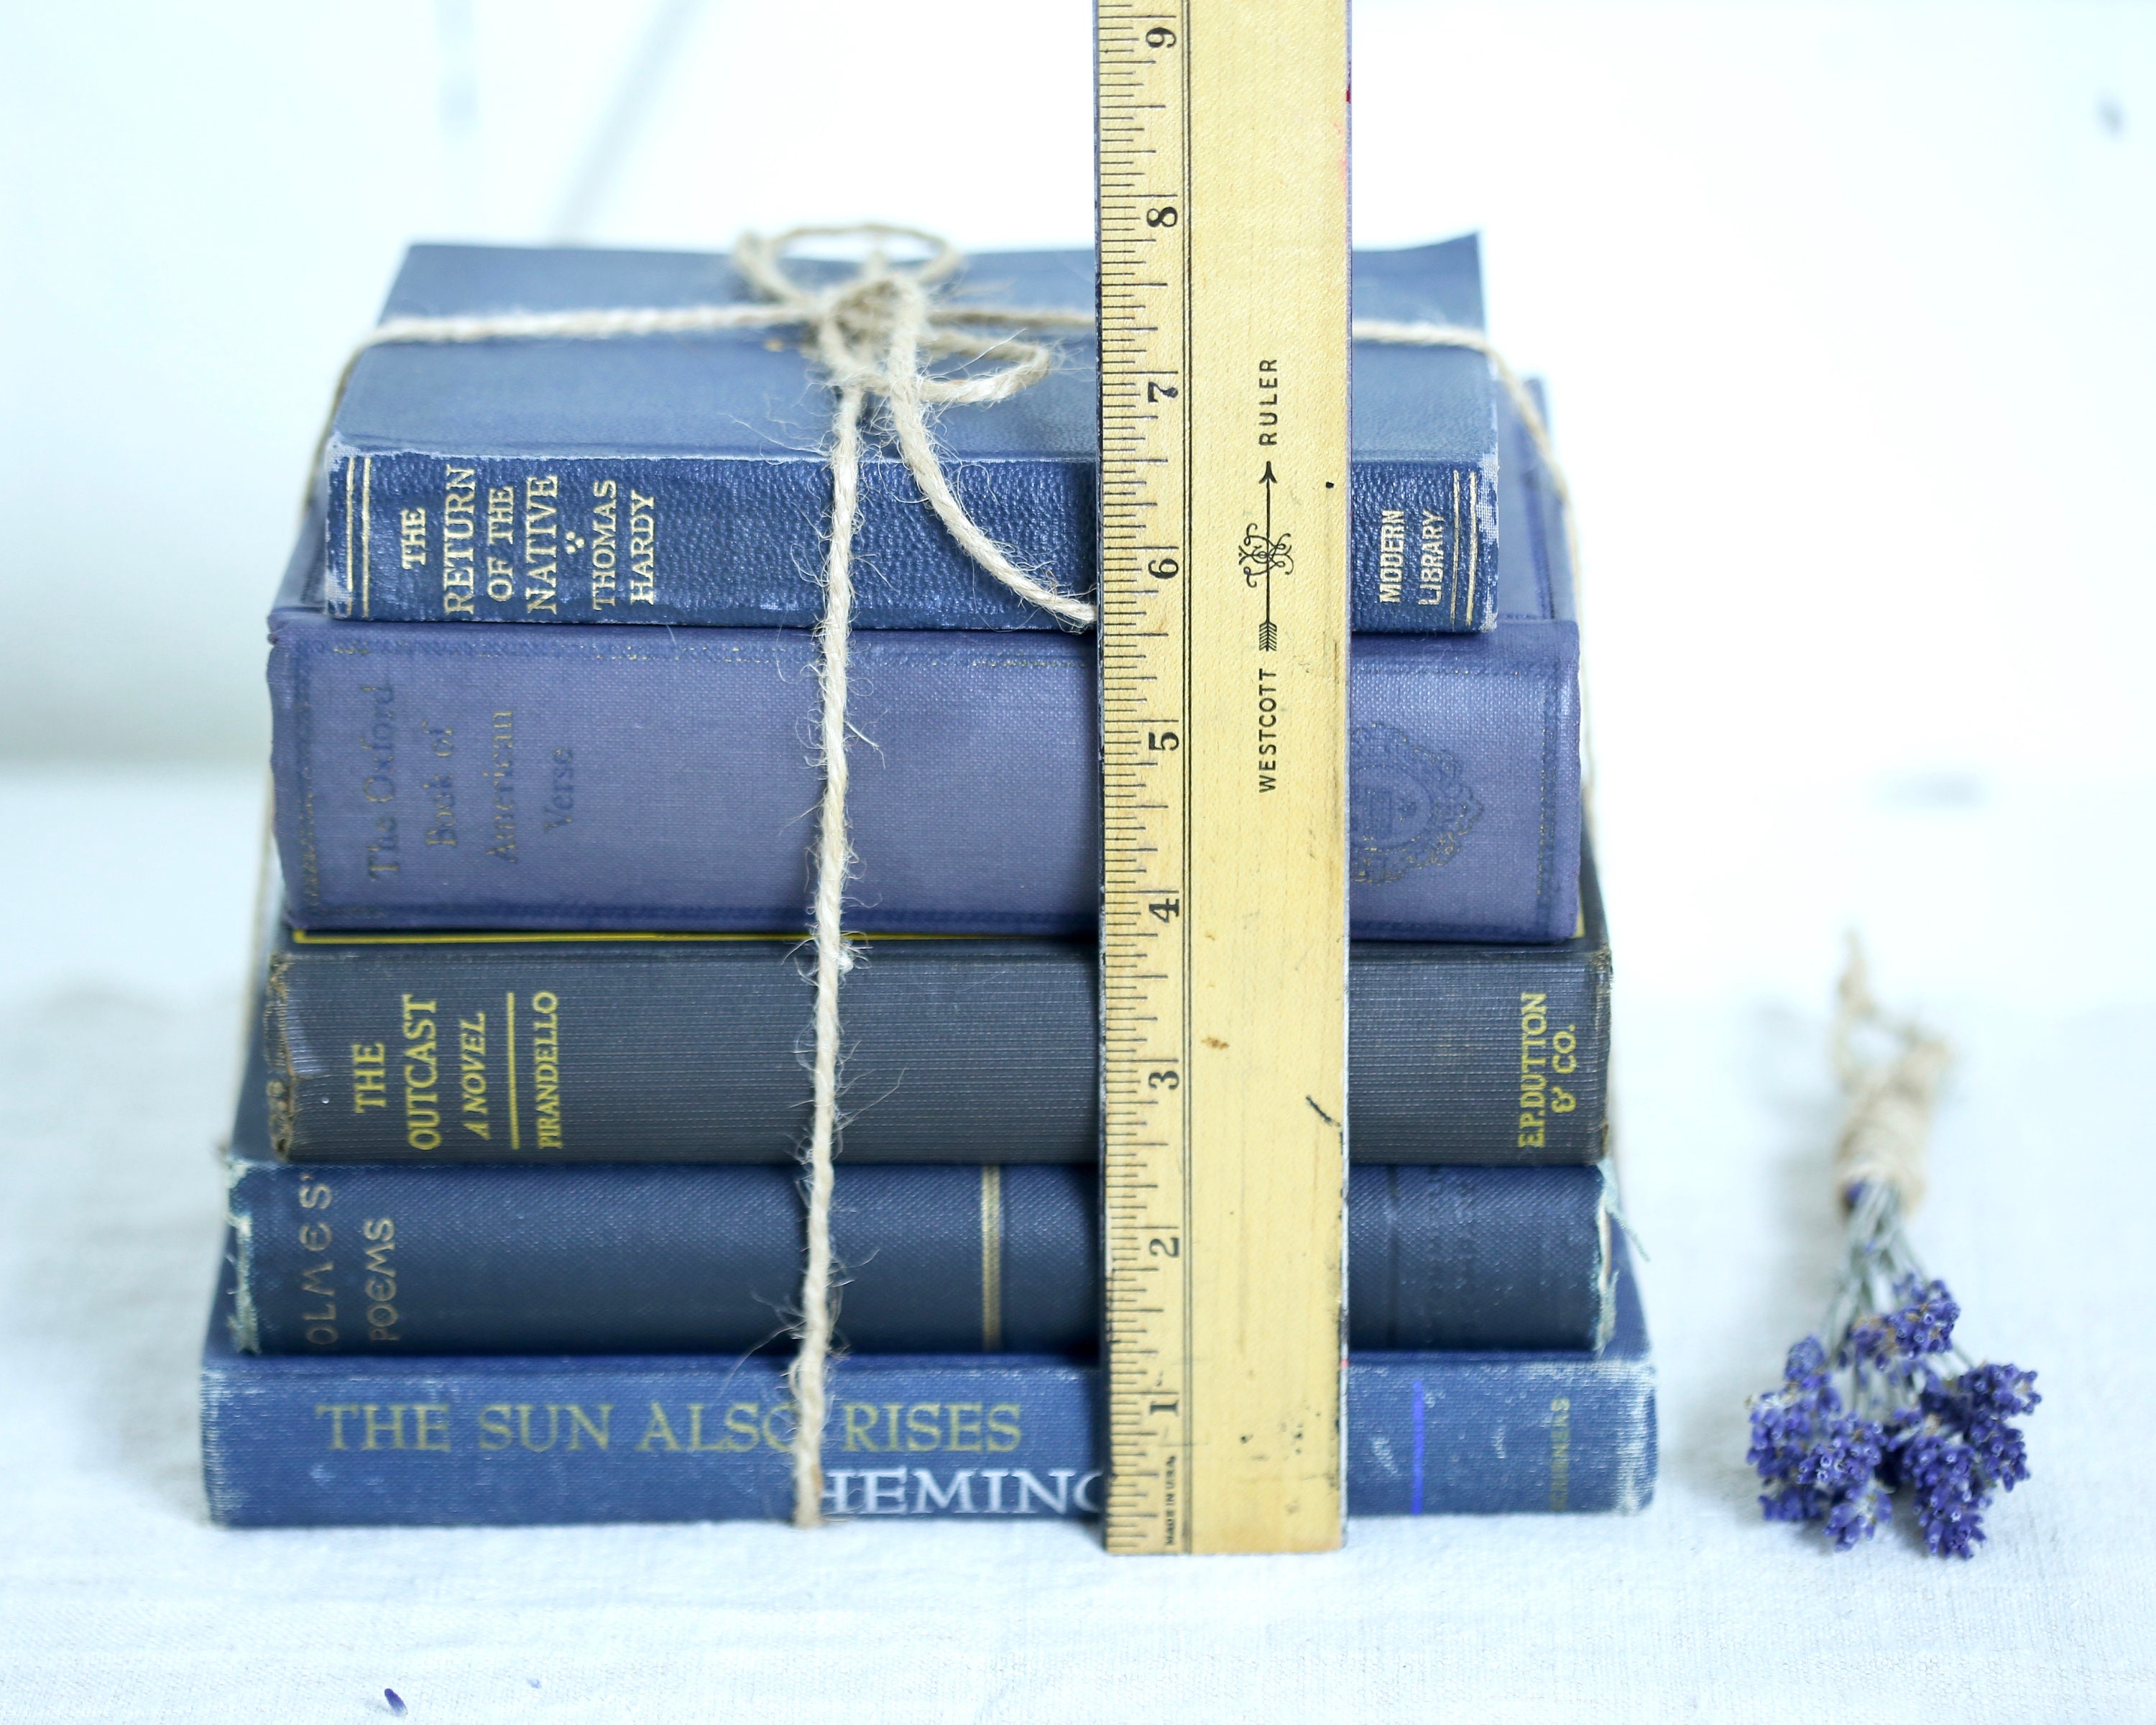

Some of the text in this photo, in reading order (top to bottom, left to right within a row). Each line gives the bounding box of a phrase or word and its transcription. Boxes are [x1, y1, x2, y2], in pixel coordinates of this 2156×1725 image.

[1146, 27, 1177, 49] 9
[1146, 206, 1179, 229] 8
[1148, 381, 1179, 403] 7
[400, 507, 427, 570] THE
[443, 464, 476, 615] RETURN
[487, 486, 515, 602] OF THE
[525, 473, 558, 615] NATIVE
[591, 479, 617, 611] THOMAS
[630, 489, 655, 605] HARDY
[1148, 558, 1179, 580] 6
[1258, 359, 1279, 794] WESTCOTT RULER
[1378, 510, 1405, 603] MODERN
[1418, 508, 1445, 605] LIBRARY
[359, 682, 400, 881] The Oxford
[420, 720, 458, 847] Book of
[482, 709, 518, 864] American
[1148, 732, 1180, 753] 5
[543, 748, 573, 833] Verse
[1149, 898, 1179, 924] 4
[351, 1041, 387, 1113] THE
[402, 993, 443, 1150] OUTCAST
[460, 1011, 492, 1141] A NOVEL
[532, 990, 563, 1149] PIRANDELLO
[1148, 1070, 1179, 1091] 3
[1552, 1024, 1577, 1113] & CO.
[363, 1217, 400, 1342] POEMS
[1150, 1237, 1180, 1258] 2
[314, 1403, 453, 1452] THE
[476, 1403, 614, 1453] SUN
[843, 1402, 1022, 1453] RISES
[1150, 1399, 1179, 1417] 1
[1165, 1494, 1176, 1506] IN
[1165, 1509, 1176, 1545] MADE
